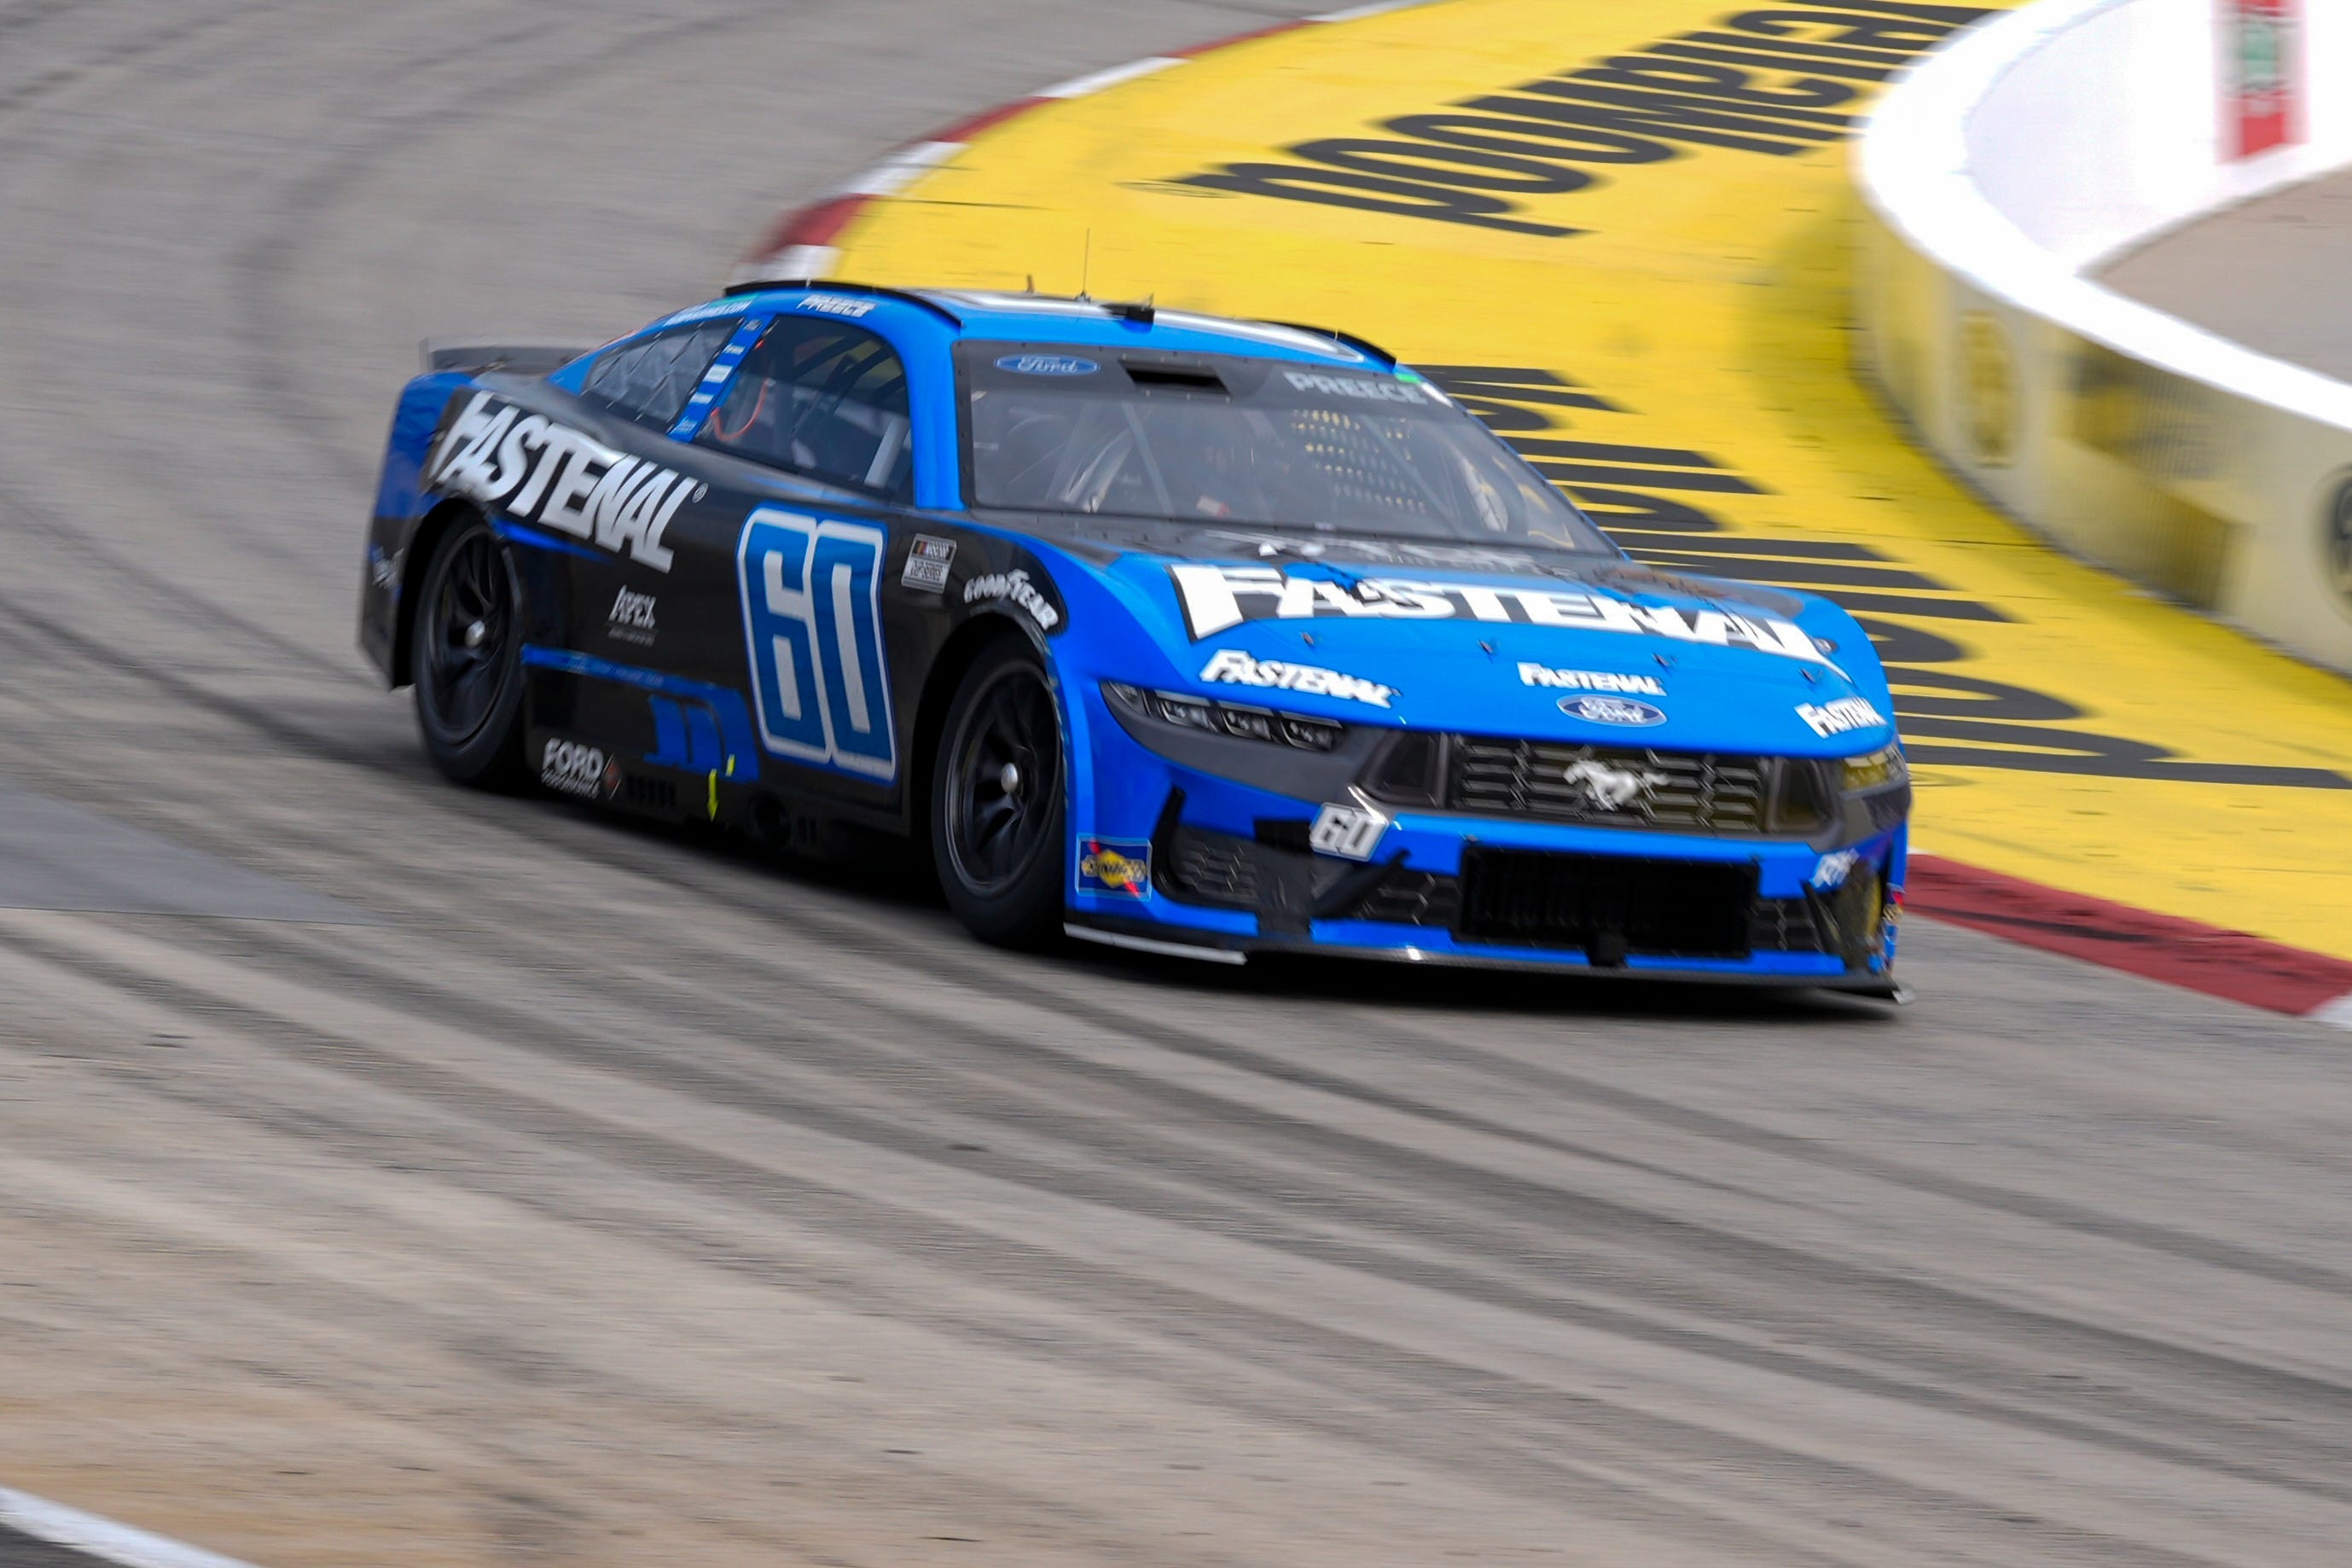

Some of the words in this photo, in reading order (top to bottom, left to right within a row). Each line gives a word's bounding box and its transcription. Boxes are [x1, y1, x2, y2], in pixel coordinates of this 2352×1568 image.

[1176, 0, 2001, 238] ellaWood
[429, 389, 698, 573] FASTENAL
[737, 507, 897, 781] 60
[1170, 563, 1853, 684] FASTENAL
[1199, 649, 1392, 709] FASTENAL
[1517, 662, 1667, 697] FASTENAL
[542, 737, 604, 780] FORD
